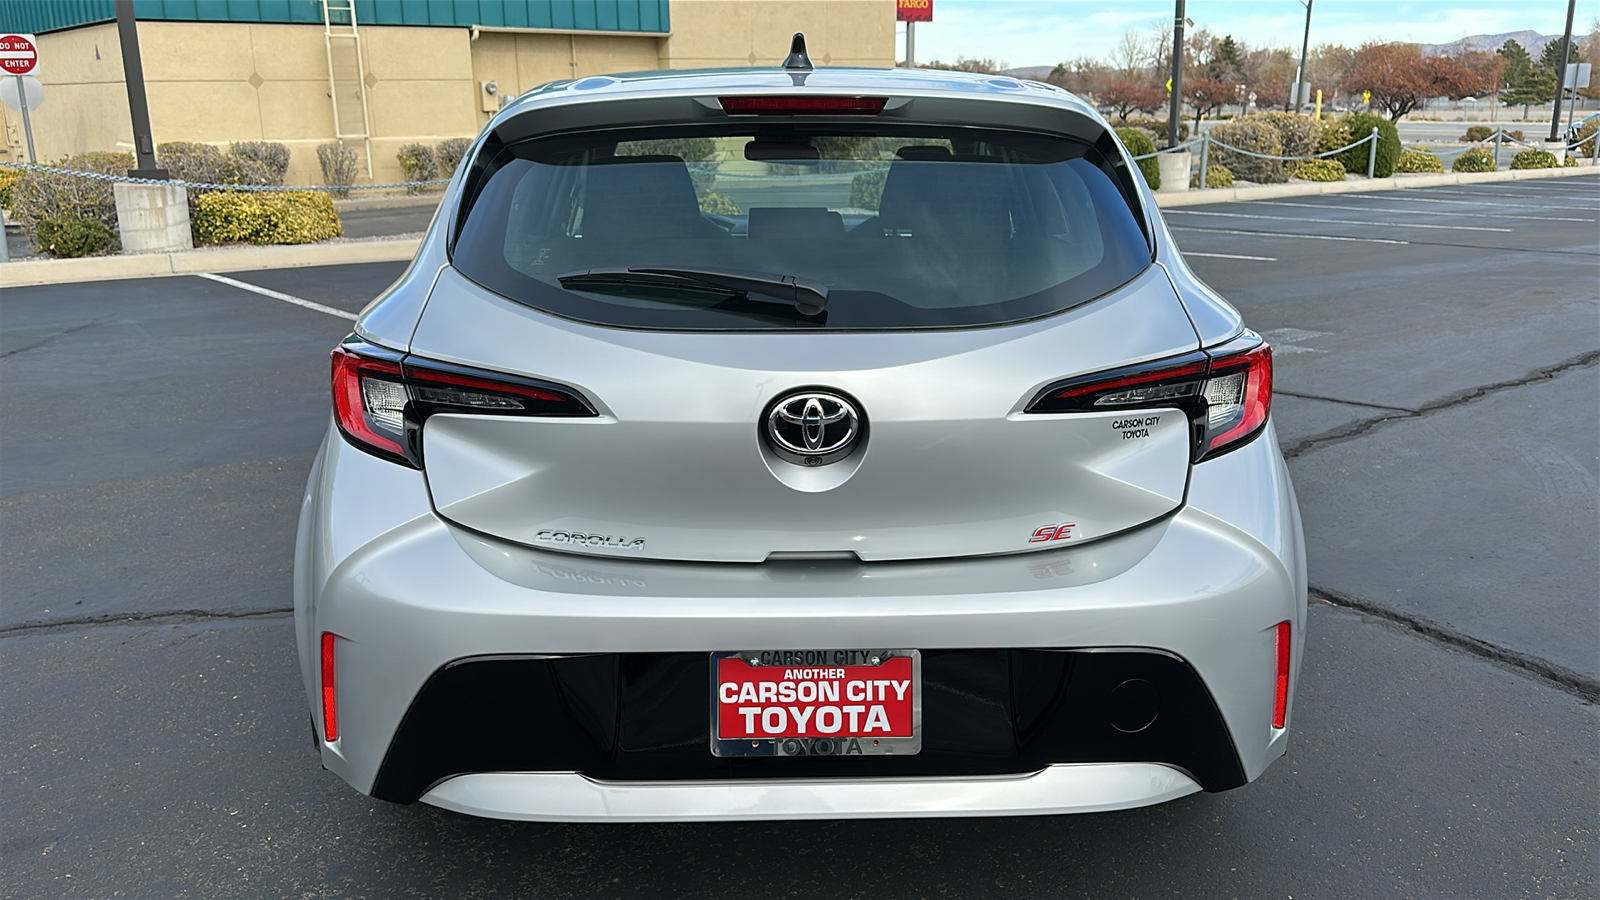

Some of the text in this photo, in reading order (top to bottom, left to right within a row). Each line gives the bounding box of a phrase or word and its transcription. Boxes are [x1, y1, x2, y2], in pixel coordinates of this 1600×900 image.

[898, 0, 929, 8] FARGO
[0, 42, 29, 50] DO NOT
[1112, 416, 1161, 430] CARSON CITY
[1122, 428, 1150, 440] TOYOTA
[534, 529, 646, 551] COROLLA
[1028, 522, 1076, 543] SE
[760, 650, 871, 666] CARSON CITY
[784, 668, 846, 680] ANOTHER
[719, 679, 911, 704] CARSON CITY
[738, 705, 892, 734] TOYOTA
[773, 737, 864, 756] TOYOTA
